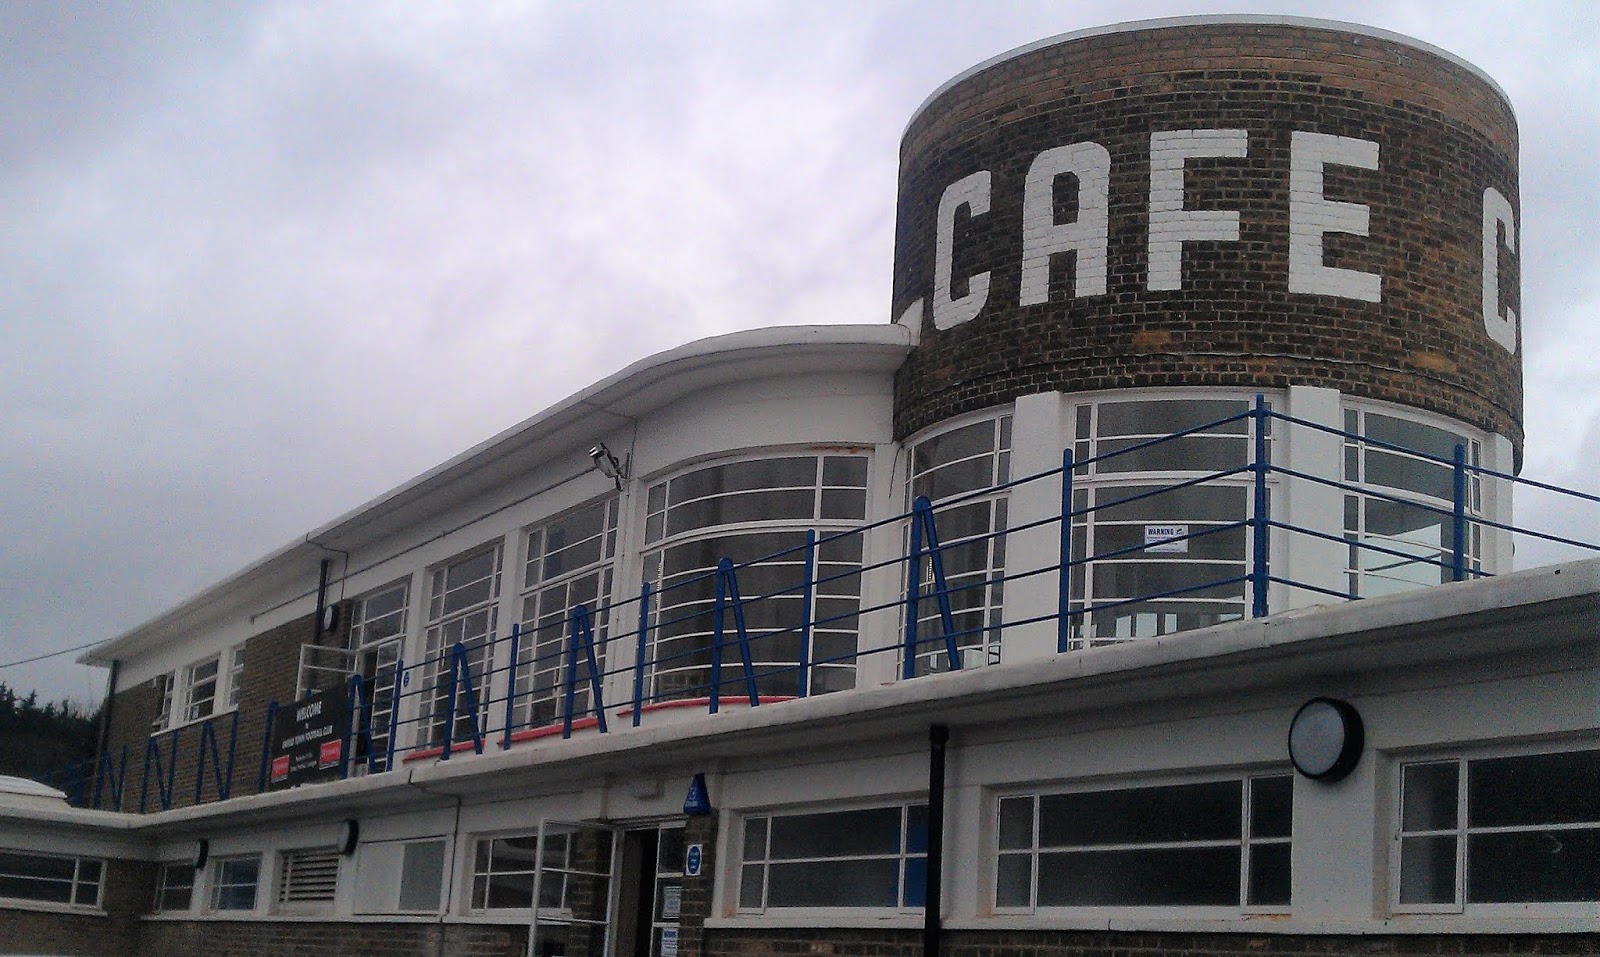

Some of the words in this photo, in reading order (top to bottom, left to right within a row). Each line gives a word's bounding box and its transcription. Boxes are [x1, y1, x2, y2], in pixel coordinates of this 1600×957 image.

[934, 129, 1382, 331] CAFE
[1147, 528, 1174, 536] WARNING
[296, 701, 322, 721] WELCOME
